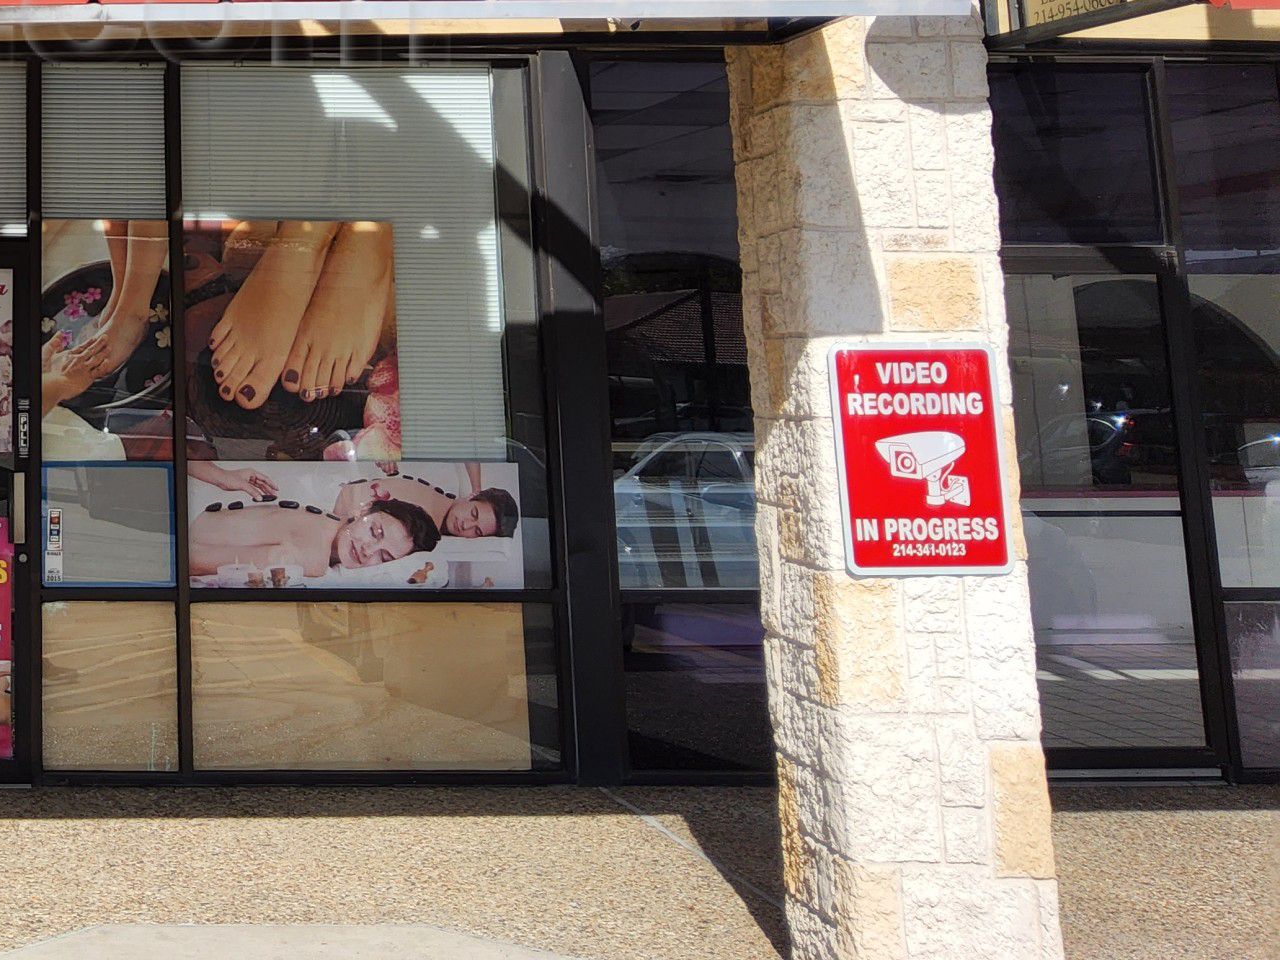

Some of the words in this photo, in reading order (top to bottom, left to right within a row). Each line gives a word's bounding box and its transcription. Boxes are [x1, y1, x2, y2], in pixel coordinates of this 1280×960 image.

[875, 362, 947, 384] VIDEO
[847, 392, 984, 416] RECORDING
[855, 518, 879, 541] IN
[885, 517, 999, 541] PROGRESS
[892, 543, 967, 557] 214-341-0123
